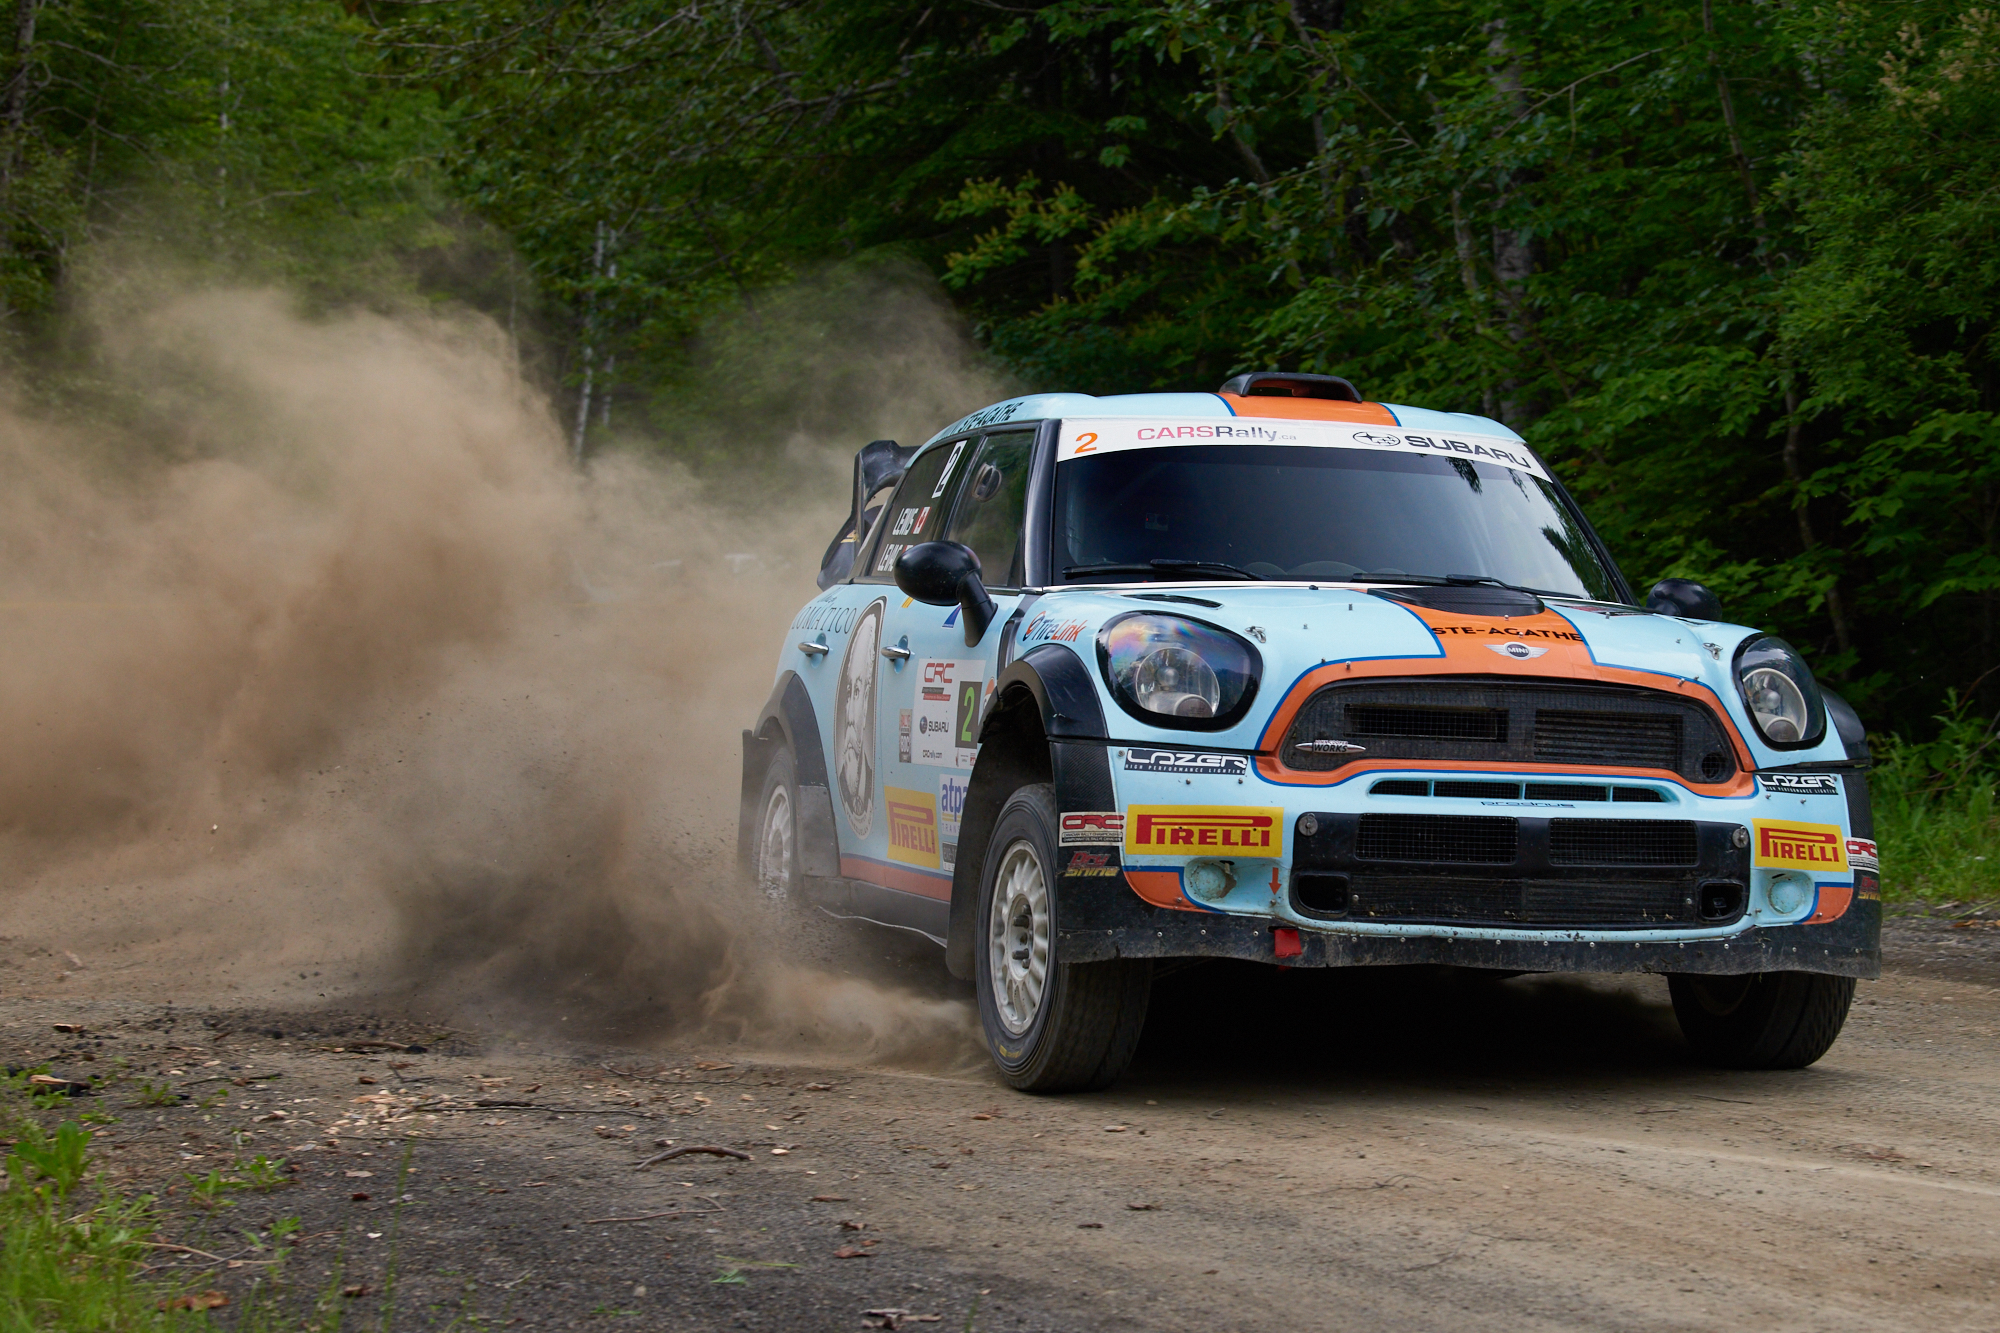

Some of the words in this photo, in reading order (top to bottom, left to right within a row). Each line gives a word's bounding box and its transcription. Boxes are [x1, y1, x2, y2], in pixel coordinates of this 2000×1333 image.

[1074, 432, 1099, 454] 2
[1404, 435, 1532, 469] SUBARU
[934, 446, 962, 493] 2
[1031, 618, 1089, 643] TireLink
[1431, 626, 1584, 642] STE-AGATHE
[1506, 646, 1530, 656] MINI
[924, 662, 955, 684] CRC
[960, 686, 976, 742] 2
[928, 720, 950, 733] SUBARU
[1314, 744, 1348, 753] WORKS
[1127, 749, 1248, 769] LAZER
[1148, 765, 1204, 773] PERFORMANCE
[1756, 774, 1837, 788] LAZER
[888, 800, 936, 855] PIRELLI
[1062, 814, 1125, 830] CRC
[1135, 814, 1273, 847] PIRELLI
[1760, 827, 1840, 862] PIRELLI
[1845, 840, 1878, 859] CRC
[1070, 851, 1110, 869] Dry
[1064, 866, 1119, 877] Shine
